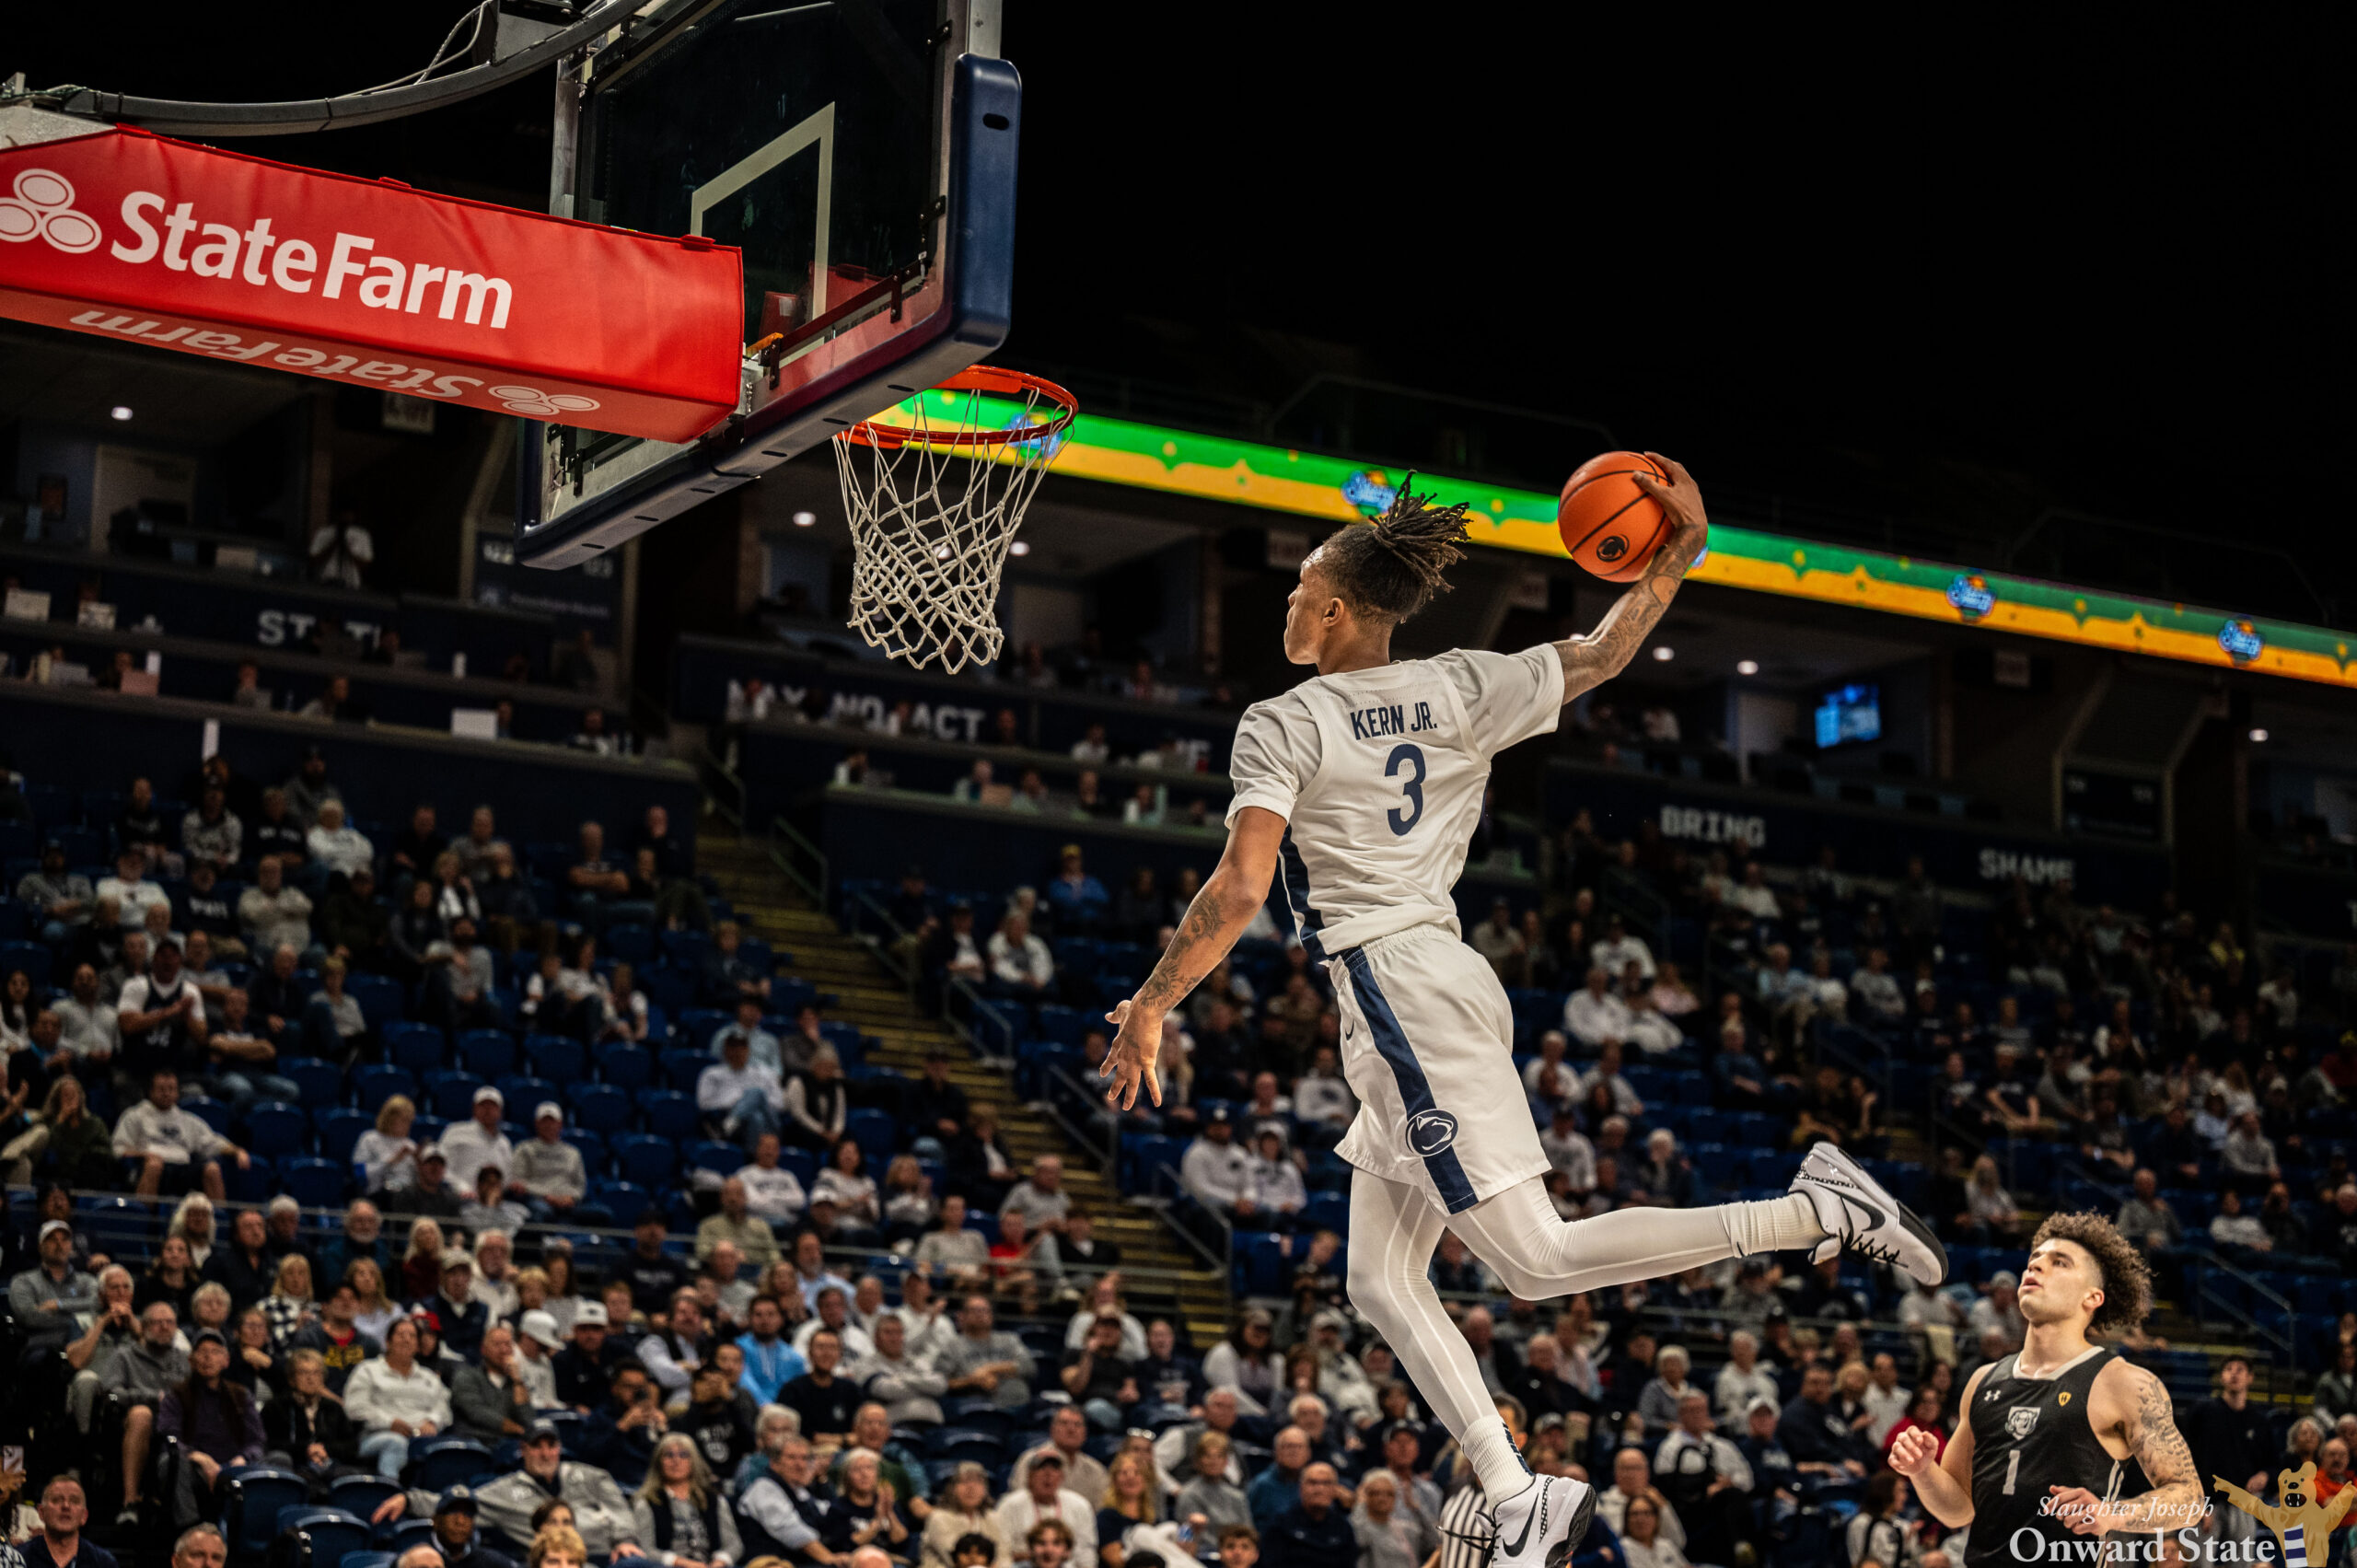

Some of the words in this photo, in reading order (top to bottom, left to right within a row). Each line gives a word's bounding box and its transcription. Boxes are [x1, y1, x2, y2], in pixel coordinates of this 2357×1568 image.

[257, 609, 383, 653] STT
[911, 702, 985, 742] ACT
[1350, 704, 1405, 740] KERN
[1411, 702, 1438, 733] JR.
[1385, 744, 1426, 837] 3
[1659, 803, 1767, 848] BRING
[1978, 847, 2076, 889] SHAME
[2002, 1449, 2021, 1496] 1
